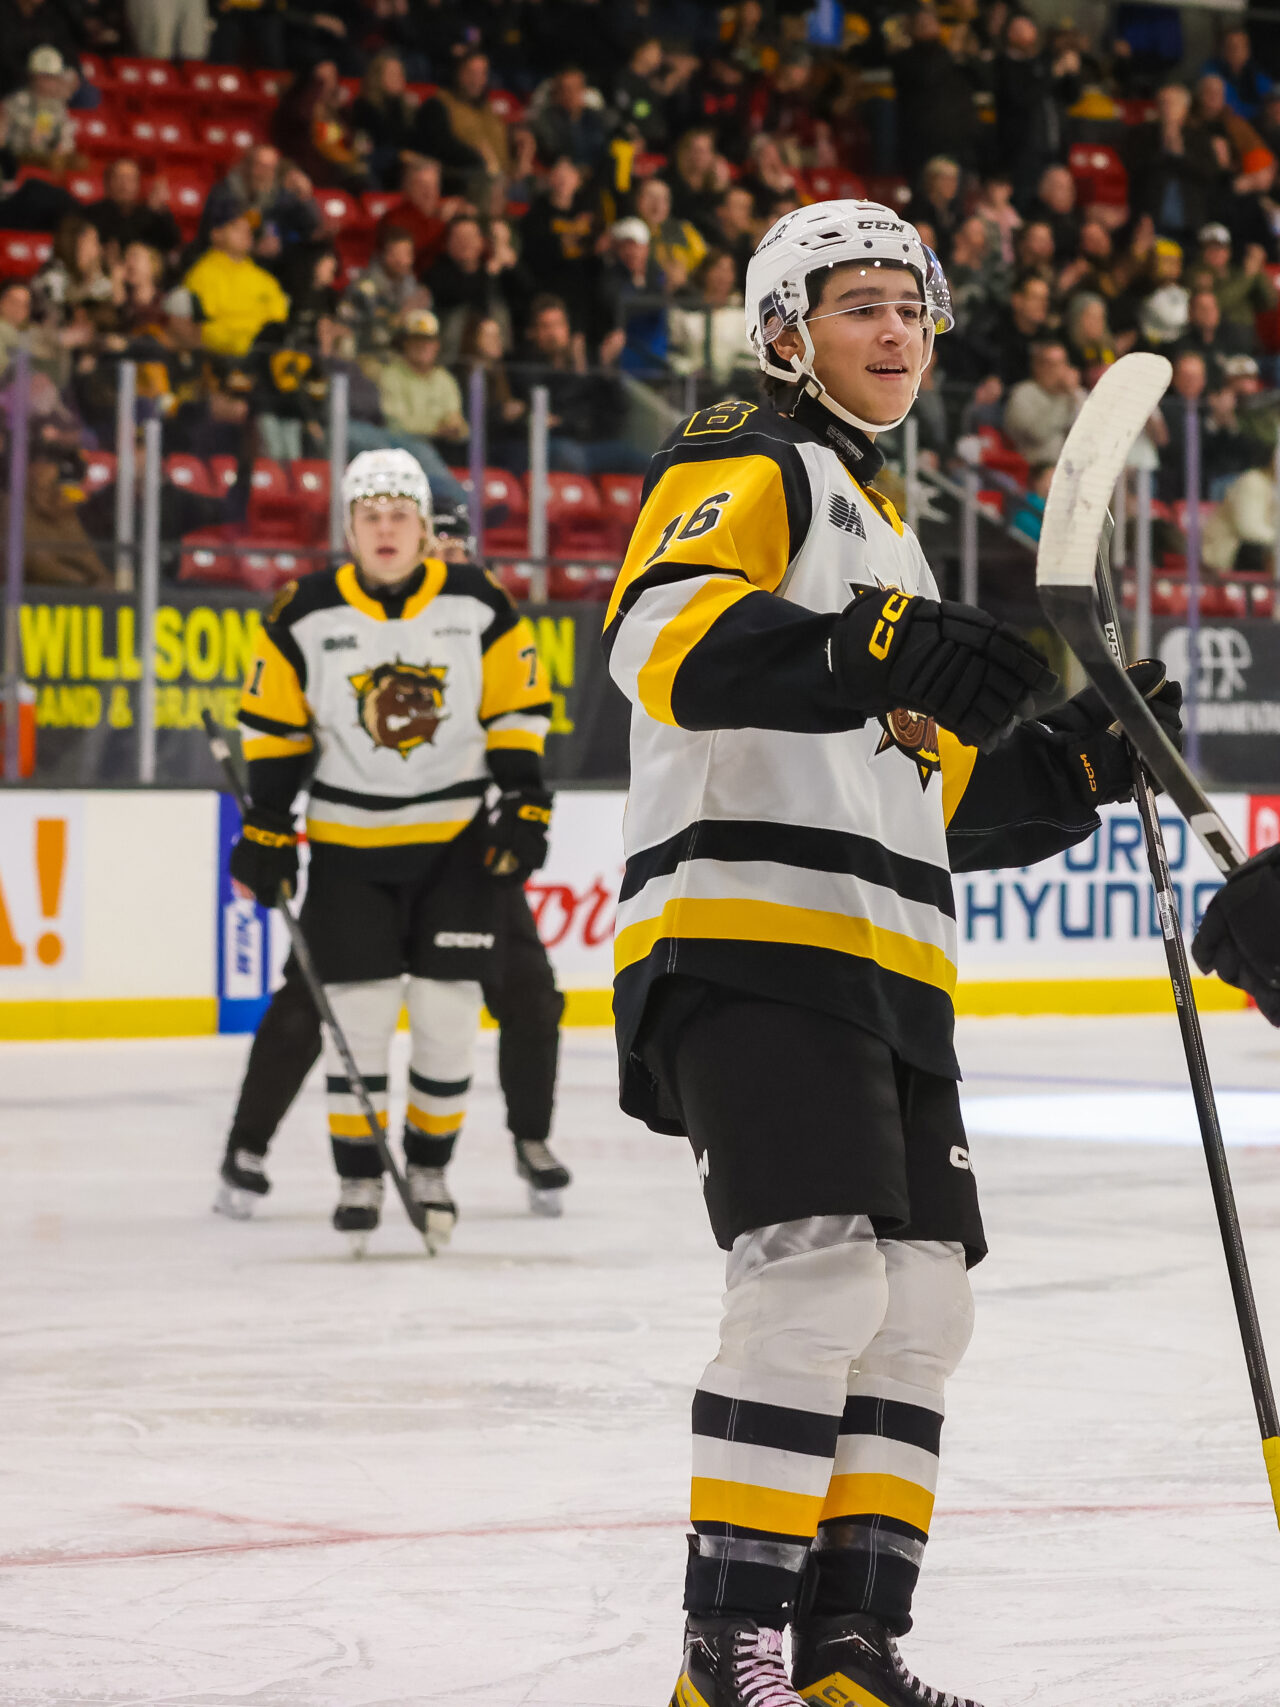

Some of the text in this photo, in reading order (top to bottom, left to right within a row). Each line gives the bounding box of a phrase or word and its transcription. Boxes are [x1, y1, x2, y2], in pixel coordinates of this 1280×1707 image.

[856, 220, 905, 233] CCM
[683, 399, 759, 437] B
[641, 489, 734, 570] 16
[19, 604, 262, 681] WILLSON
[868, 590, 915, 661] CC
[36, 685, 101, 729] AND
[1080, 753, 1097, 792] CCM
